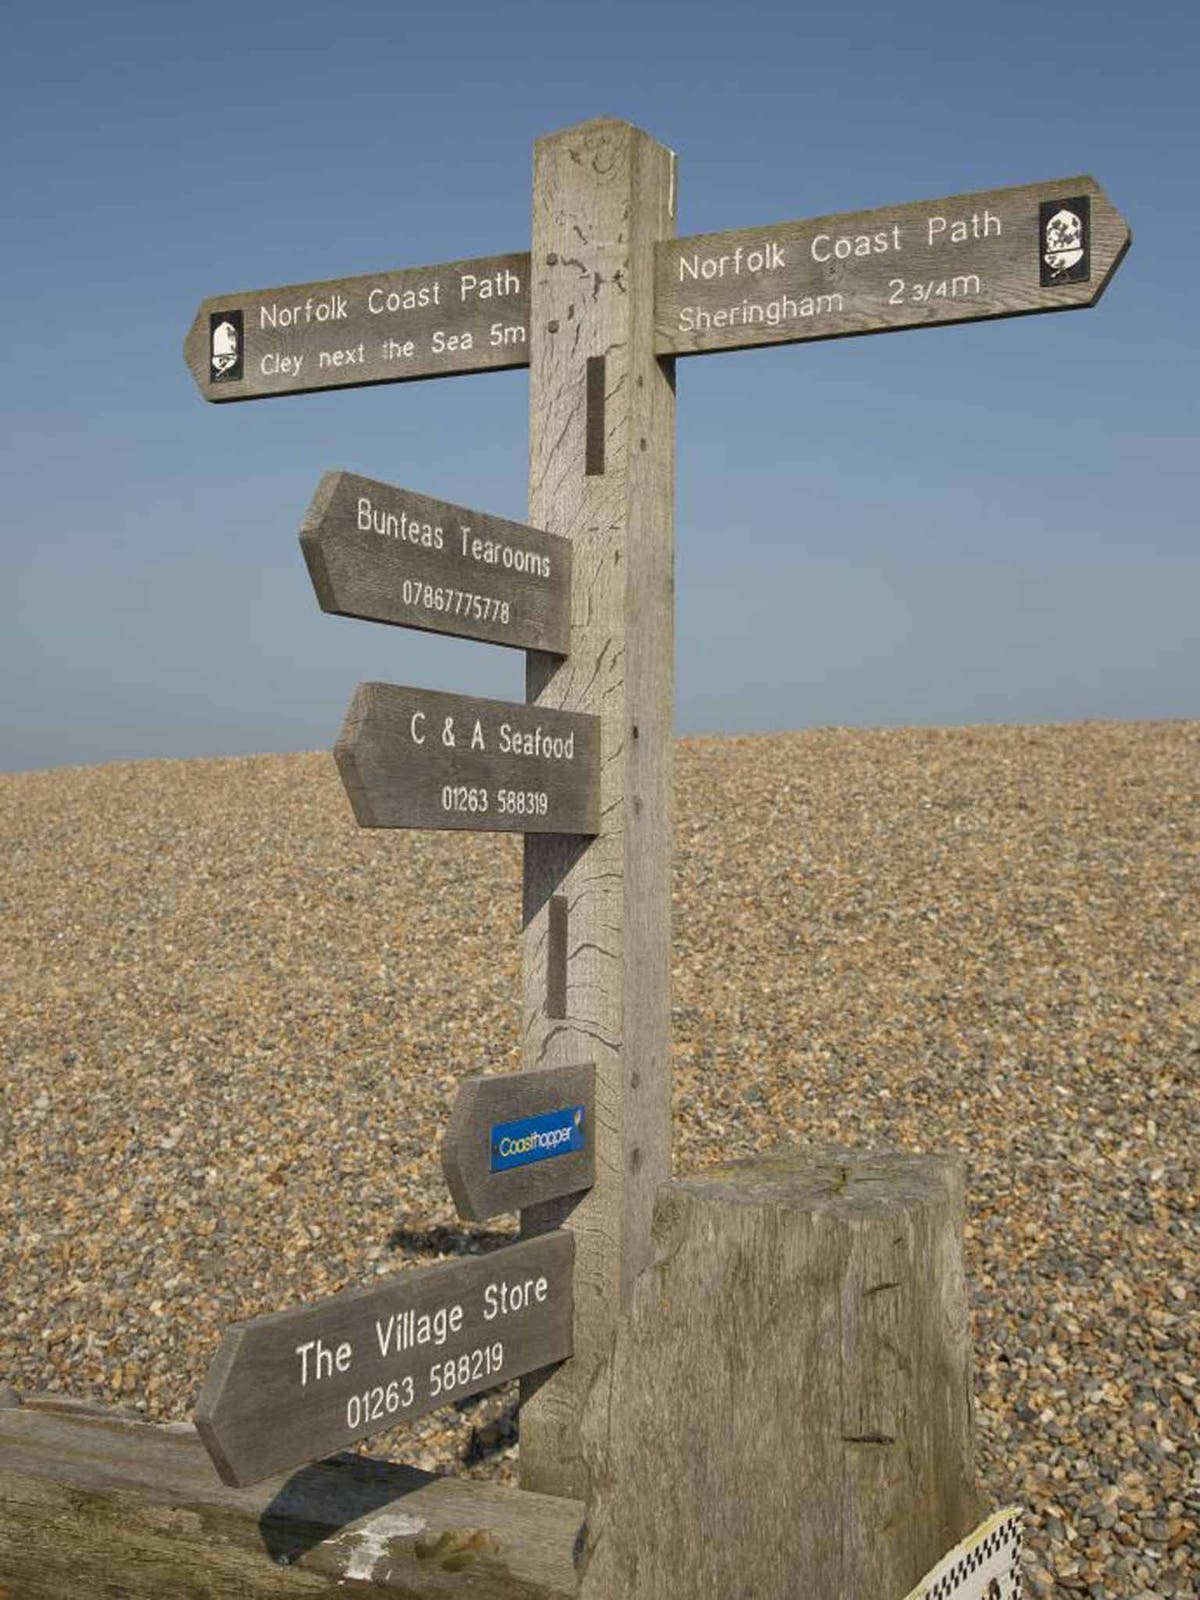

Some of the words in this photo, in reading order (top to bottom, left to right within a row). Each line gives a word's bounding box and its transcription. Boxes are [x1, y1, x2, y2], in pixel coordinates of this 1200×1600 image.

[679, 243, 787, 282] Norfolk
[810, 225, 902, 263] Coast
[928, 211, 1001, 245] Path
[260, 295, 349, 329] Norfolk
[367, 281, 440, 314] Coast
[460, 269, 521, 301] Path
[678, 292, 843, 332] Sheringham
[260, 353, 304, 377] Cley
[318, 344, 365, 368] next
[382, 339, 415, 360] the
[431, 330, 474, 353] Sea
[489, 323, 526, 346] 5m
[356, 498, 444, 550] Bunteas
[460, 526, 551, 578] Tearooms
[402, 580, 510, 625] 07867775778
[410, 712, 426, 744] C
[442, 716, 456, 748] &
[471, 719, 486, 750] A
[500, 723, 575, 759] Seafood
[442, 785, 488, 812] 01263
[497, 789, 549, 815] 588319
[499, 1126, 573, 1157] Coasthopper
[296, 1338, 352, 1386] The
[376, 1303, 464, 1358] Village
[483, 1275, 549, 1321] Store
[346, 1376, 415, 1429] 01263
[429, 1341, 503, 1397] 588219
